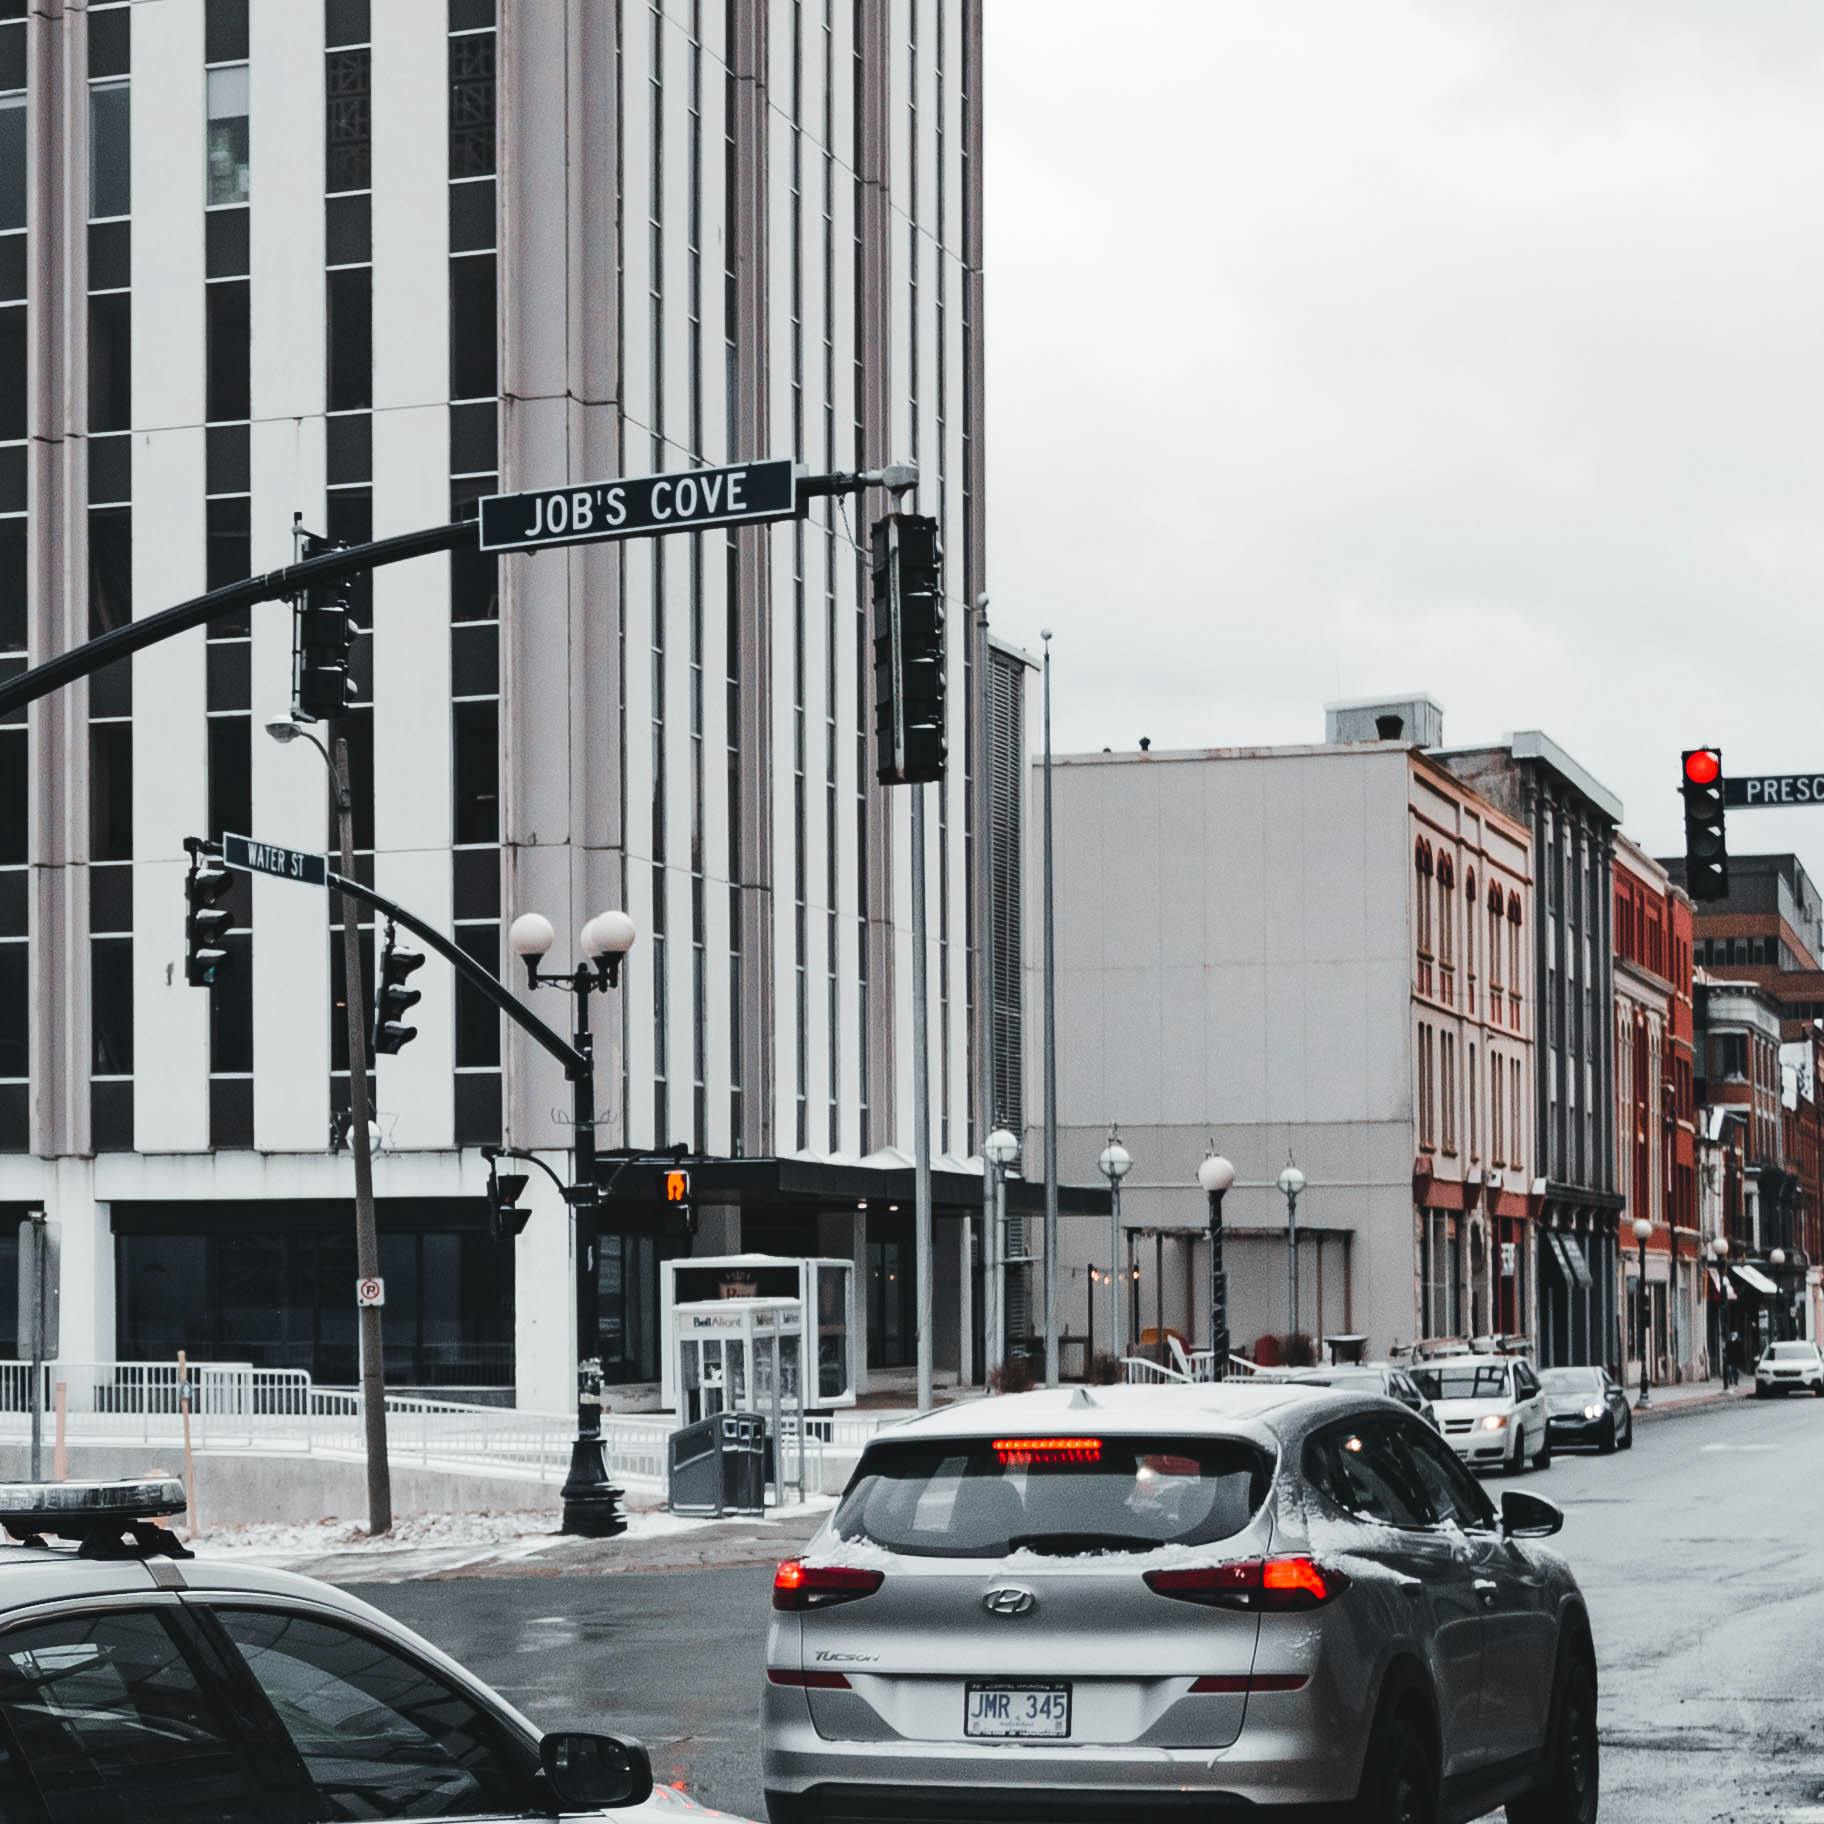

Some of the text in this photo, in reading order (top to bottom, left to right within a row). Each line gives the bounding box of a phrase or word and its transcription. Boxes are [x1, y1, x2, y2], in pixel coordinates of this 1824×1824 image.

[524, 471, 748, 537] JOB'S COVE
[1746, 777, 1824, 803] PRESC
[247, 842, 304, 878] WATER ST
[970, 1693, 1066, 1719] JMR 345
